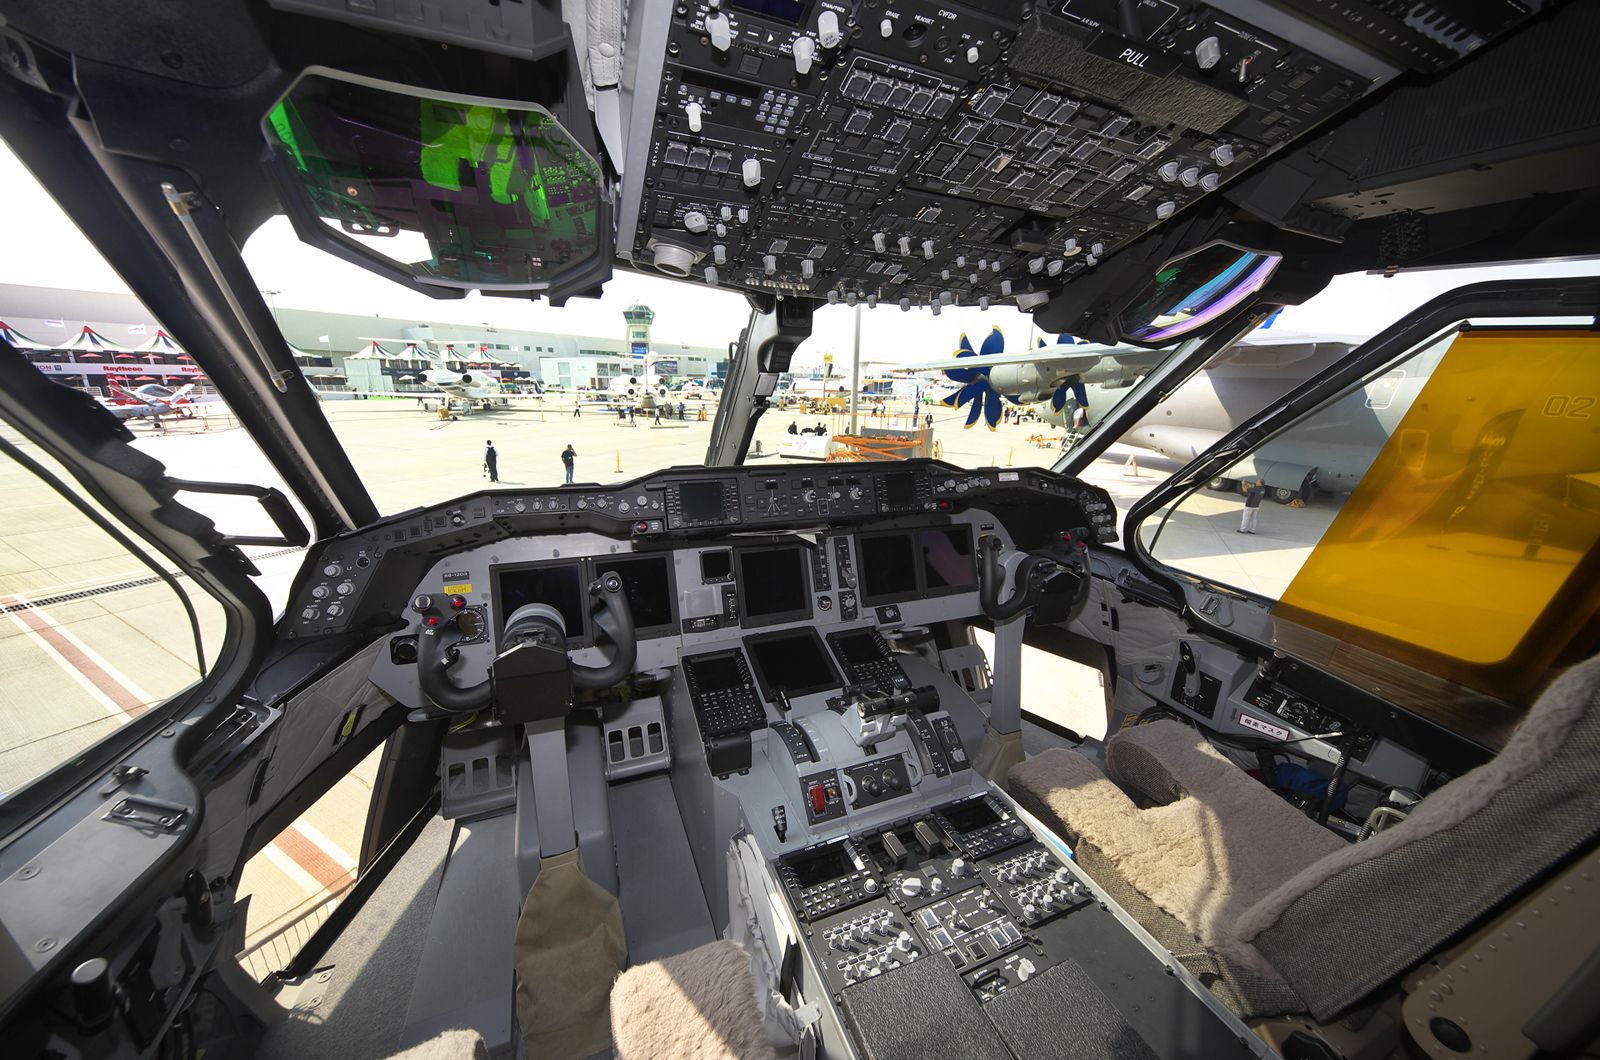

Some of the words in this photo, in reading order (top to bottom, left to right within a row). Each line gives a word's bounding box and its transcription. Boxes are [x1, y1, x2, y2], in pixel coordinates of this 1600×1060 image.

[885, 10, 900, 20] ERASE
[914, 14, 934, 25] HEADSET
[938, 10, 958, 20] CVFDR
[1118, 48, 1150, 68] PULL
[1542, 394, 1597, 419] 02
